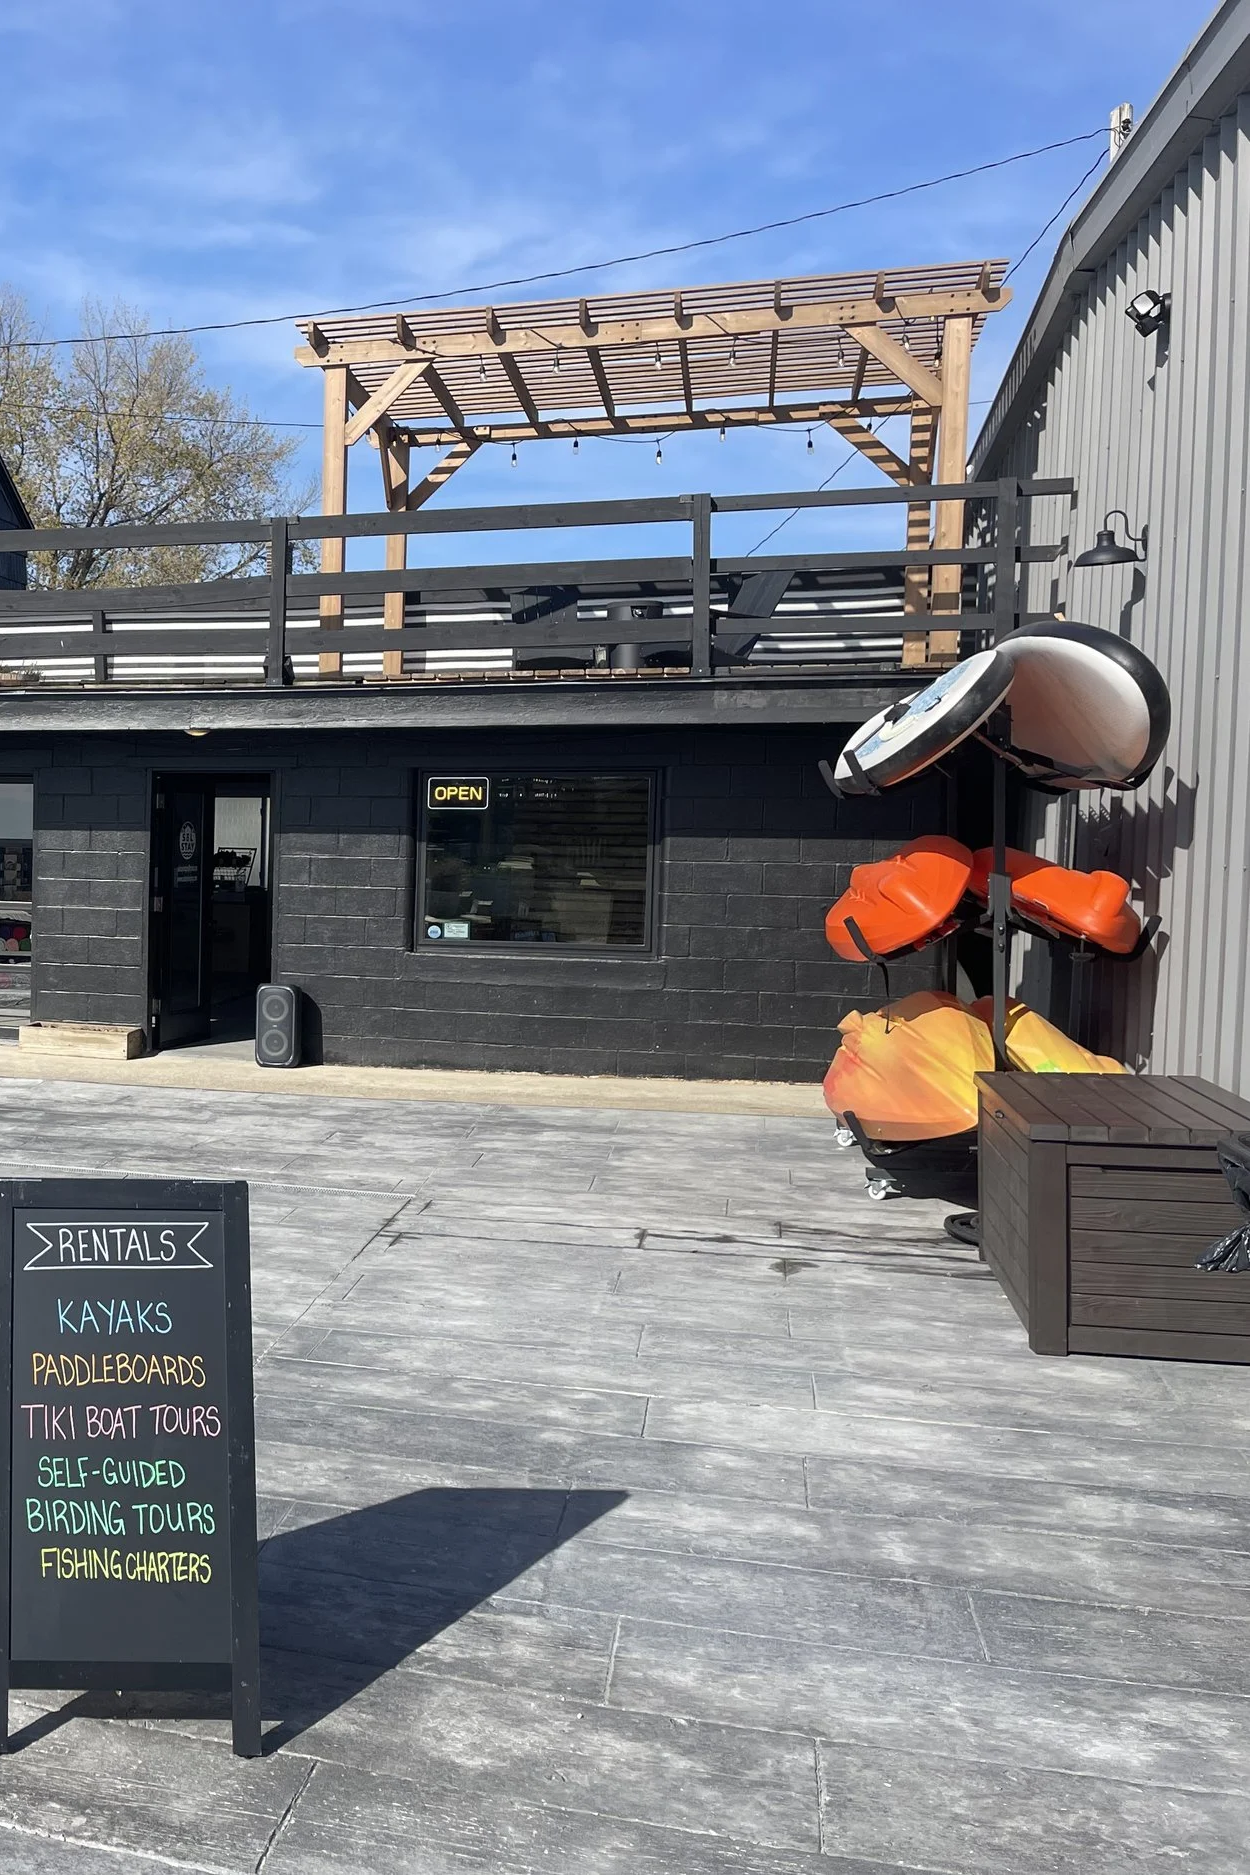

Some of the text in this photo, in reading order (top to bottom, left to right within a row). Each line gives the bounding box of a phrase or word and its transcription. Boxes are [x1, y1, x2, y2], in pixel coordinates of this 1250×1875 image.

[434, 786, 483, 801] OPEN
[58, 1227, 177, 1263] RENTALS
[57, 1298, 173, 1335] KAYAKS
[32, 1352, 206, 1388] PADDLEBOARDS
[20, 1403, 221, 1441] TIKI BOAT TOURS
[37, 1455, 186, 1489] SELF-GUIDED
[25, 1497, 216, 1536] BIRDING TOURS
[40, 1547, 212, 1583] FISHING CHARTERS
